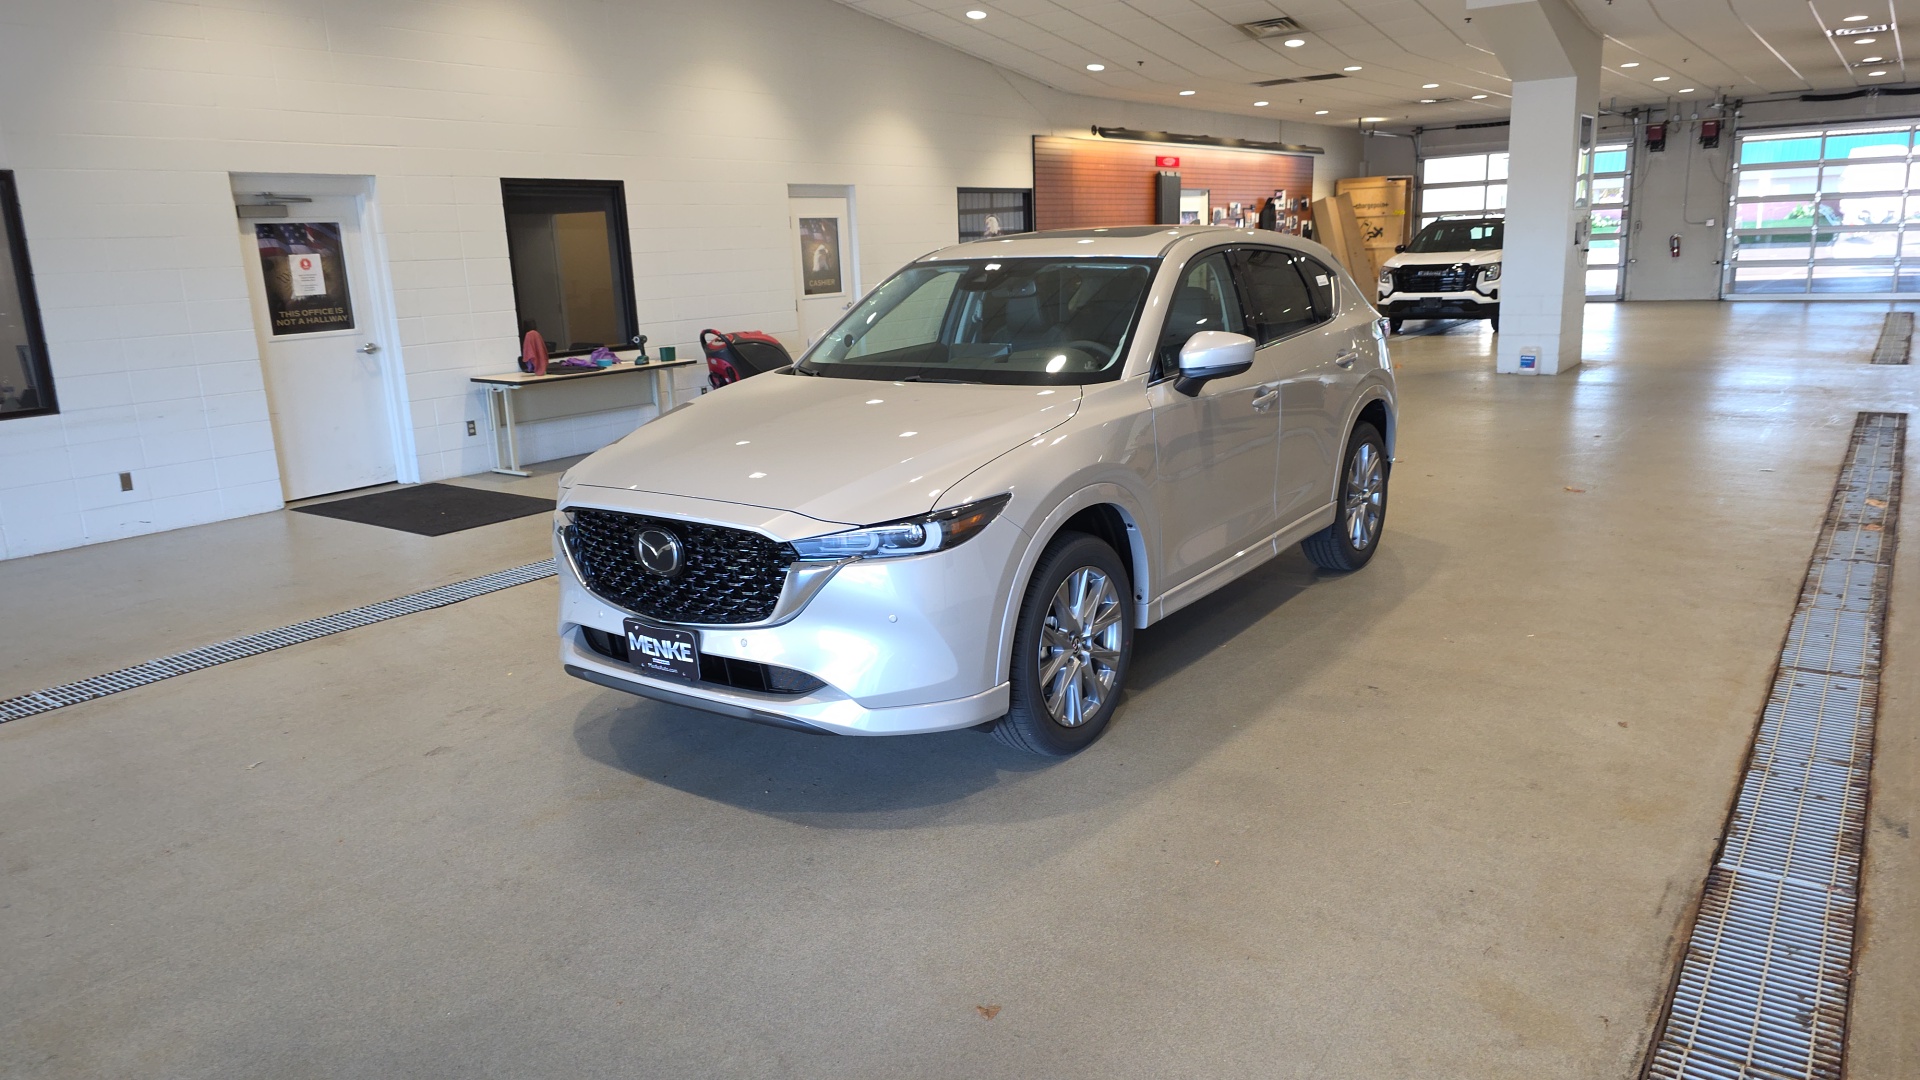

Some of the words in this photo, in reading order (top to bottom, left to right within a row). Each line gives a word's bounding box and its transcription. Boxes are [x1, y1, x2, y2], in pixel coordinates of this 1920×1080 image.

[809, 279, 835, 287] CASHIER
[279, 310, 300, 318] THIS
[302, 308, 333, 316] OFFICE
[276, 318, 296, 326] NOT
[298, 317, 306, 325] A
[306, 314, 348, 324] HALLWAY
[628, 632, 693, 662] MENKE
